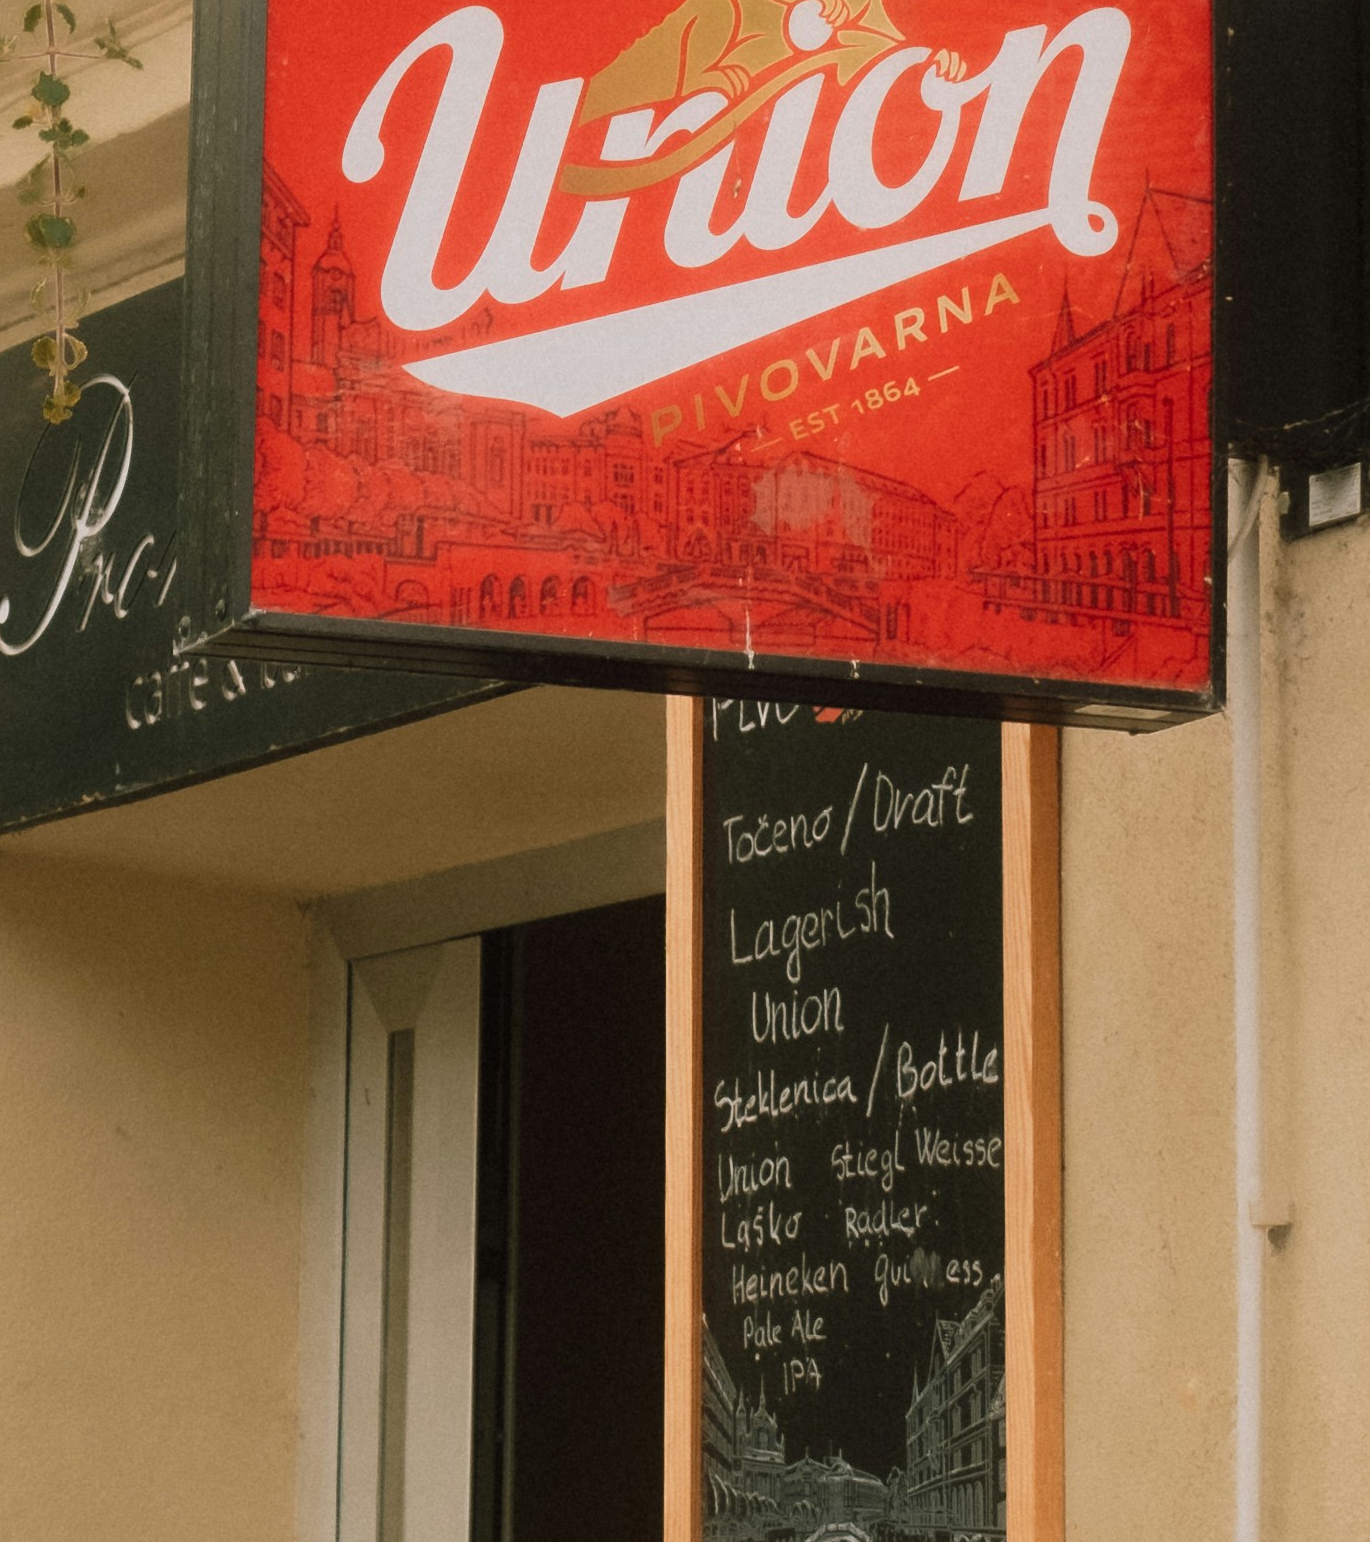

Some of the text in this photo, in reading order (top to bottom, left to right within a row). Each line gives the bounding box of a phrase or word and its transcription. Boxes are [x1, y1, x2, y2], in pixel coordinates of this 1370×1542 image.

[342, 5, 1131, 332] Union
[650, 271, 1021, 449] PIVOVARNA
[787, 376, 922, 443] EST 1864
[751, 986, 845, 1044] Union
[714, 1069, 859, 1133] Steklenica
[896, 1029, 1000, 1099] Bottle
[719, 1151, 792, 1204] Union
[831, 1126, 1003, 1193] Stiegl Weisse
[721, 1200, 803, 1249] Laško
[844, 1199, 928, 1239] Radler
[732, 1252, 849, 1306] Heineken
[744, 1309, 829, 1350] Pale Ale
[783, 1358, 823, 1396] IPA
